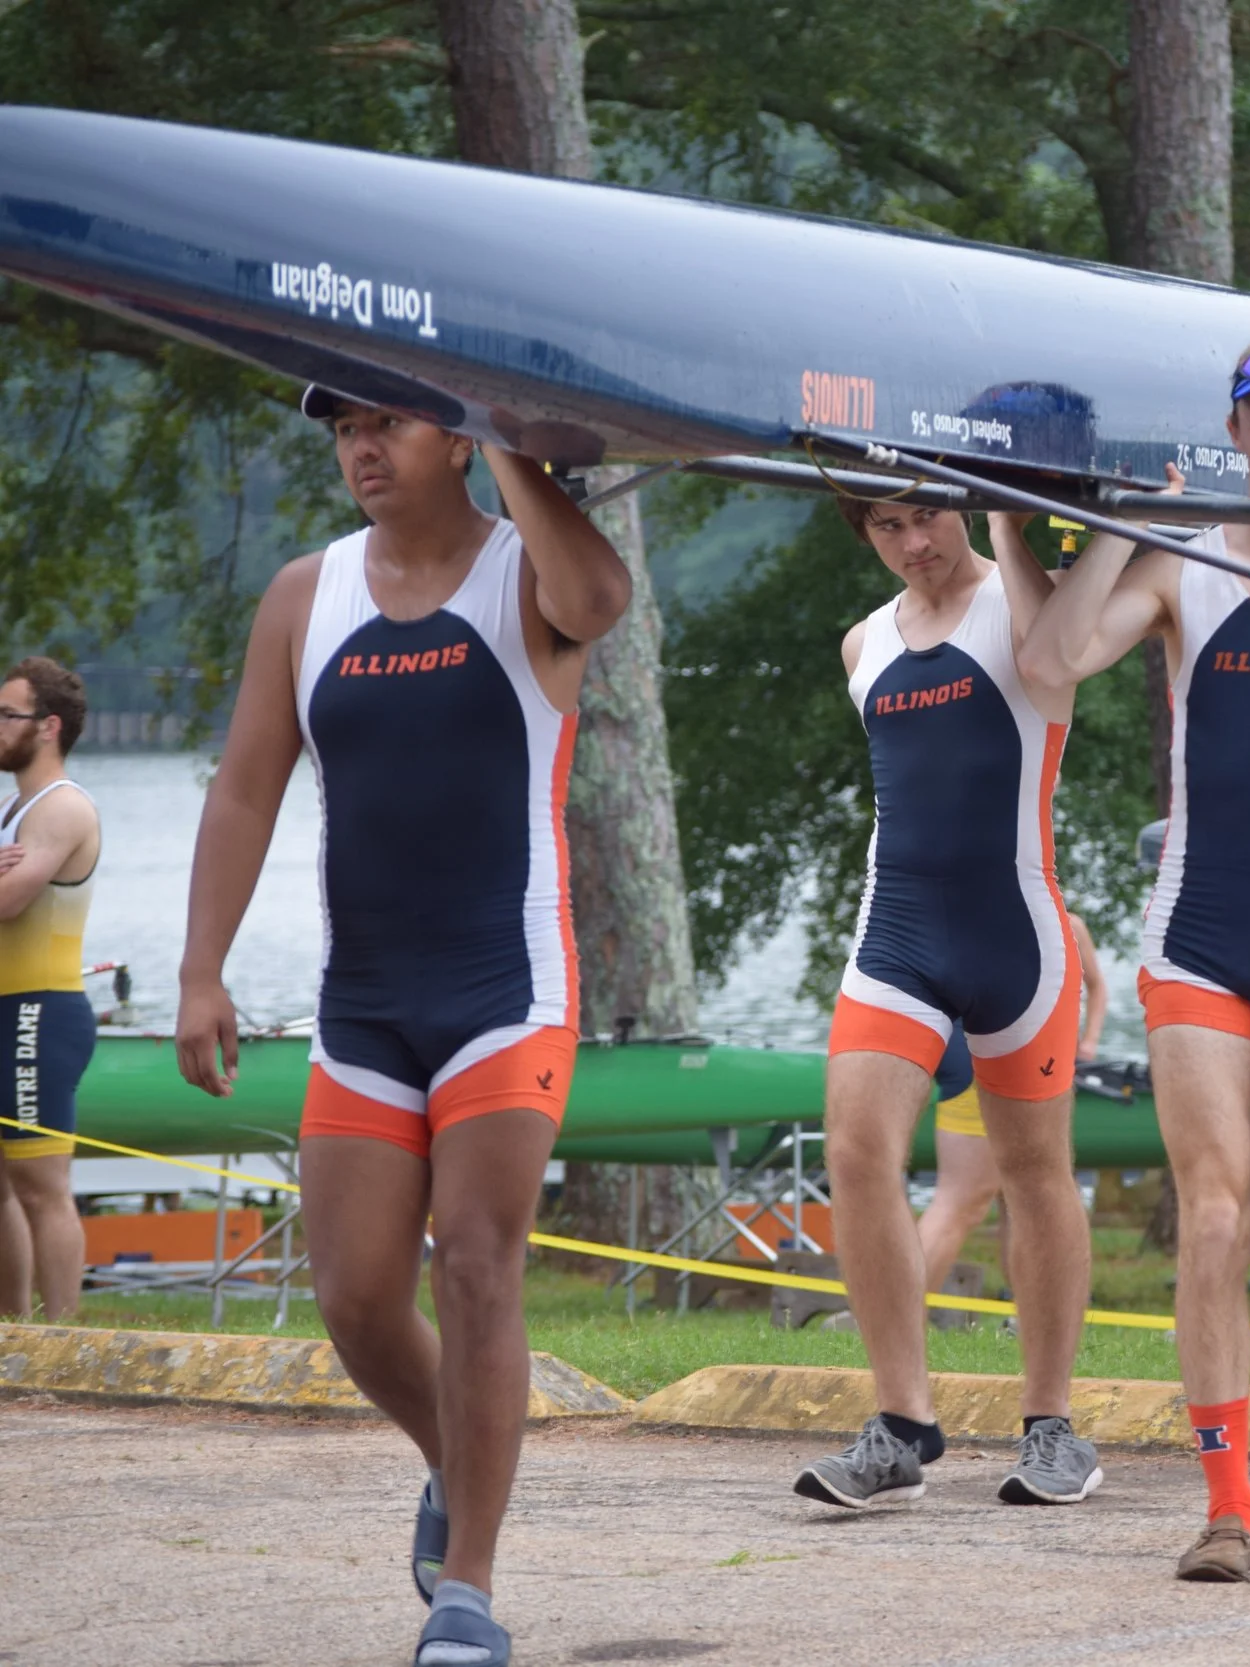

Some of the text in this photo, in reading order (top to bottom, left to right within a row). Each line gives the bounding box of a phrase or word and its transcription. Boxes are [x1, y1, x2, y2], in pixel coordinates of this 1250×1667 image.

[271, 261, 438, 338] Tom Deighan
[801, 369, 875, 431] ILLINOIS
[911, 410, 1012, 449] Stephen Caruso '56
[1177, 443, 1193, 471] '52
[1195, 446, 1224, 477] Caruso
[339, 642, 469, 676] ILLINOIS
[875, 676, 973, 715] ILLINOIS
[16, 1002, 42, 1060] DAME
